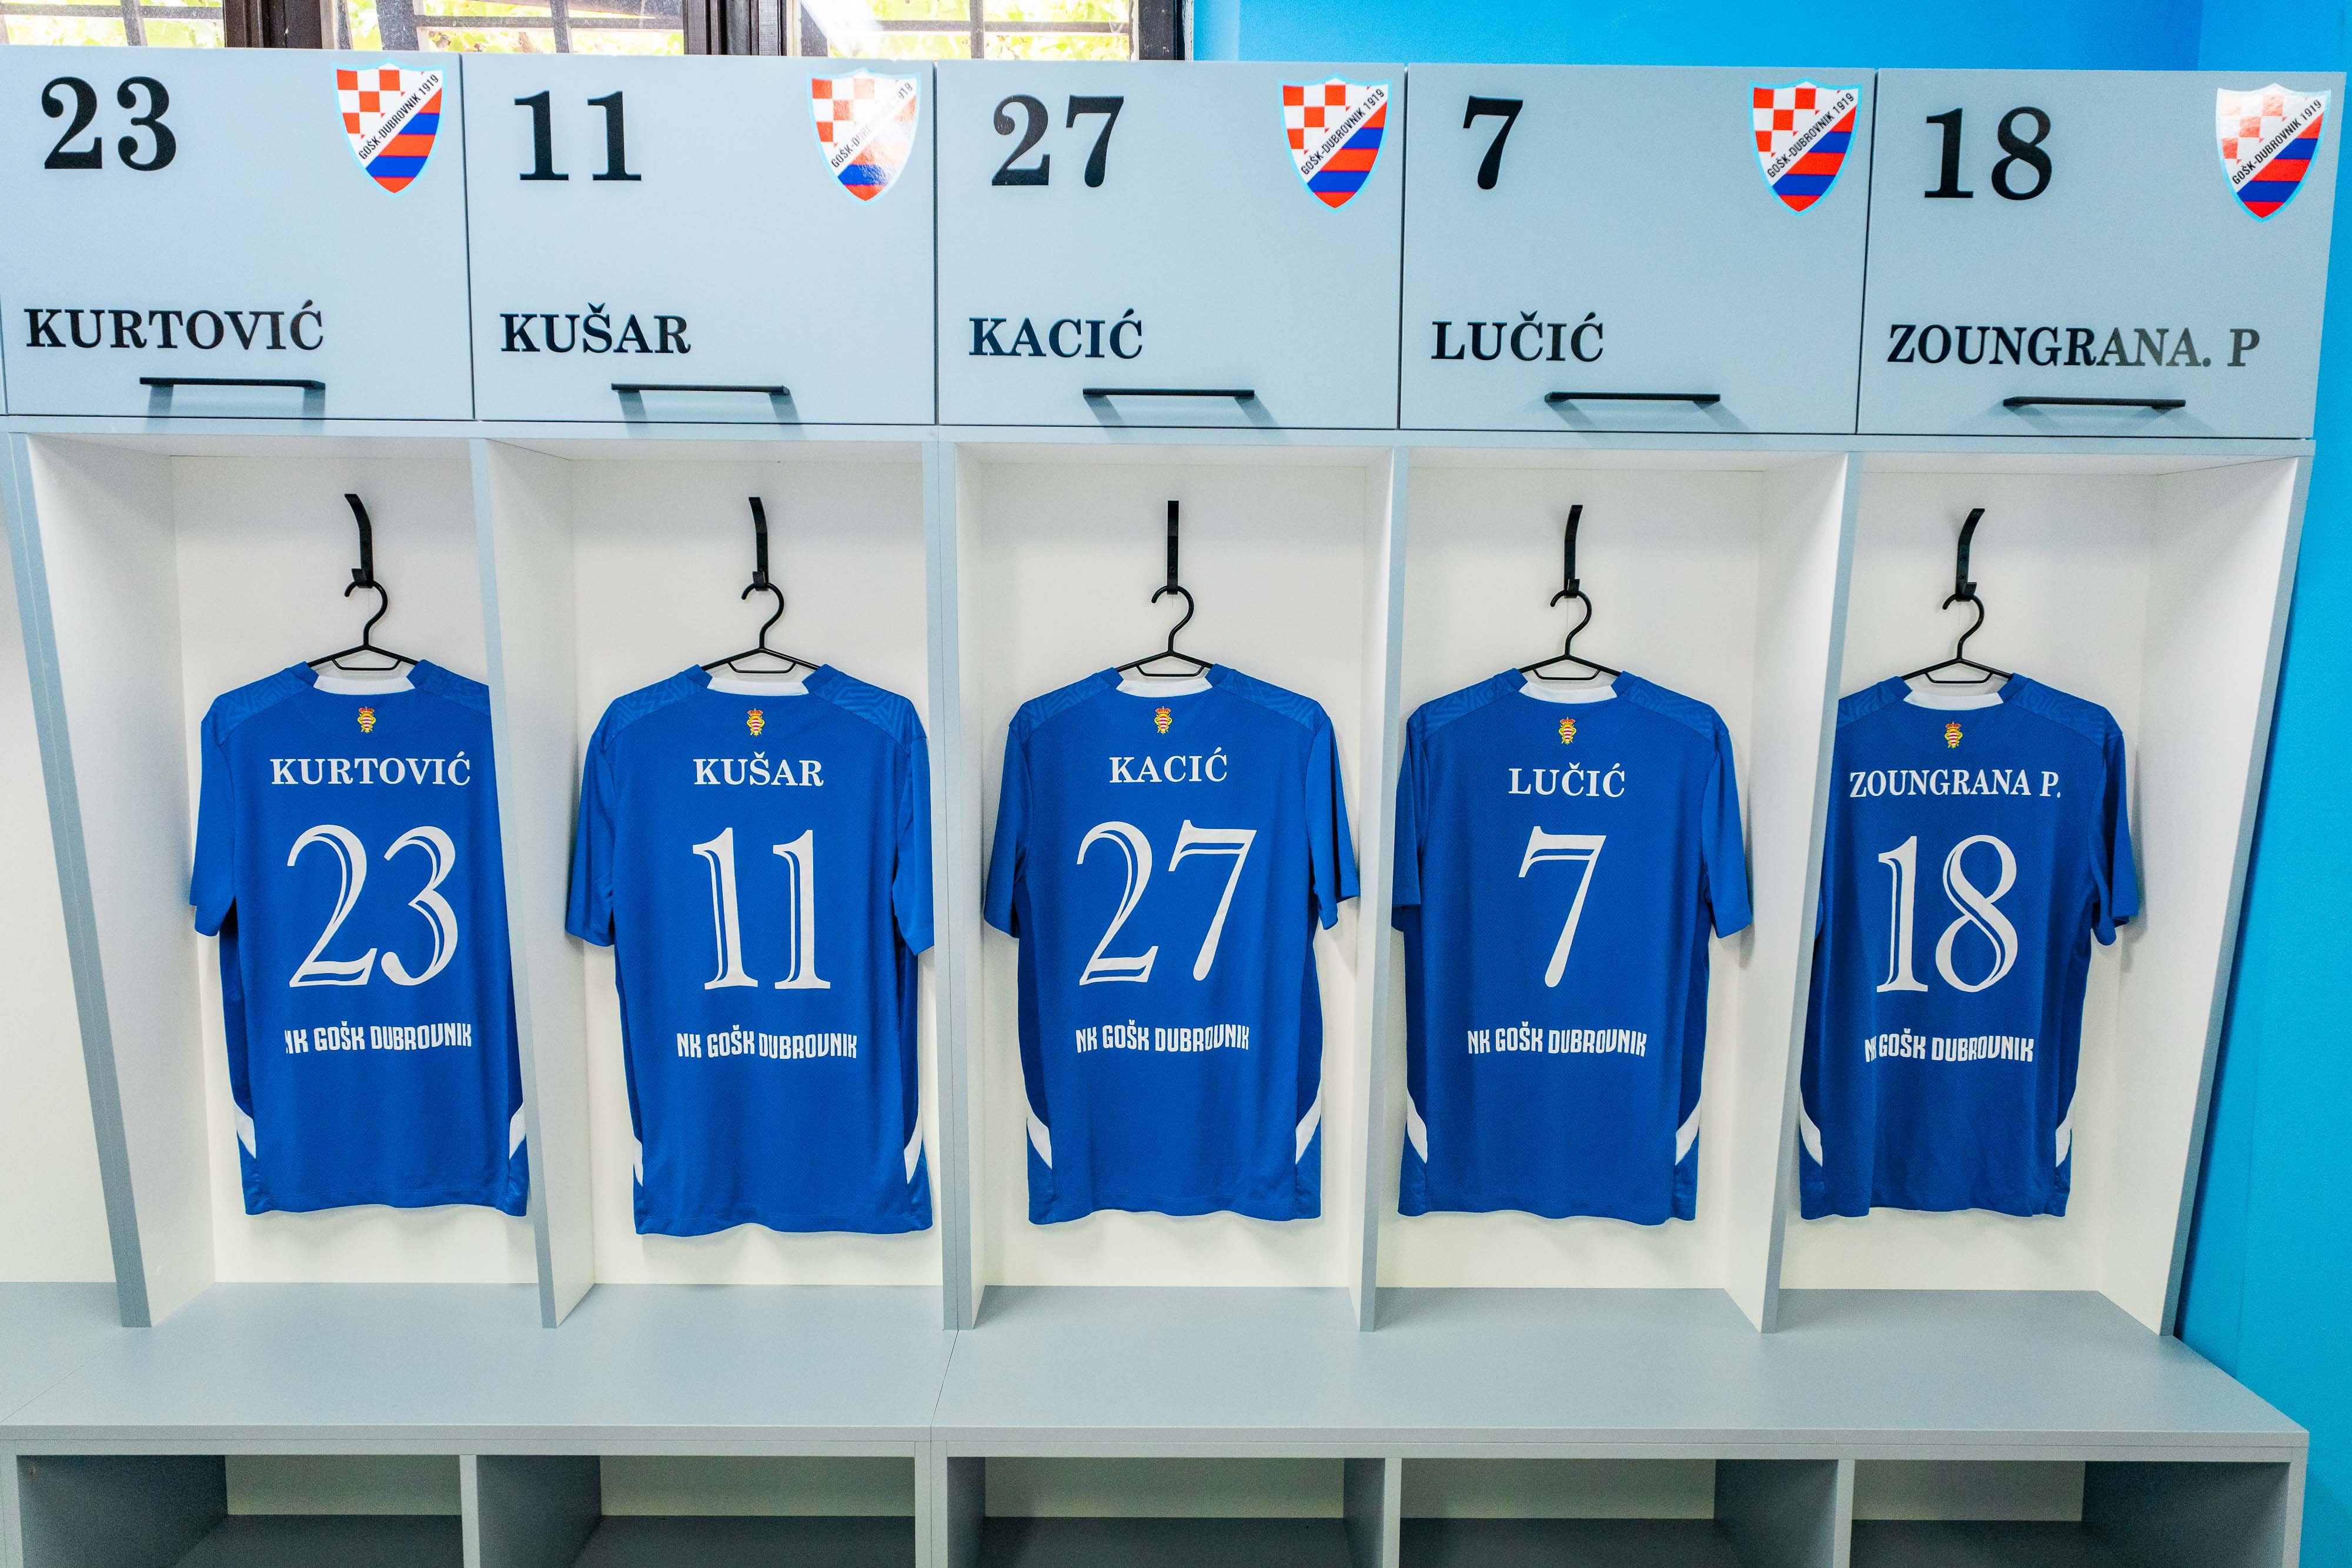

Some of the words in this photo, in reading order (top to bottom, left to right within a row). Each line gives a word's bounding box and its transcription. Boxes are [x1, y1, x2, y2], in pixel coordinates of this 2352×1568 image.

[41, 76, 177, 172] 23
[358, 92, 422, 160] GOŠK-DUBROVNIK
[418, 73, 439, 96] 1919
[514, 90, 642, 181] 11
[991, 95, 1124, 188] 27
[1300, 106, 1366, 175] GOŠK-DUBROVNIK
[1363, 88, 1385, 110] 1919
[1462, 95, 1524, 190] 7
[1766, 111, 1835, 178] GOŠK-DUBROVNIK
[1832, 92, 1855, 115] 1919
[2231, 117, 2302, 185] GOŠK-DUBROVNIK
[2300, 99, 2322, 121] 1919
[1924, 105, 2052, 201] 18
[24, 299, 324, 351] KURTOVIĆ
[499, 302, 691, 354] KUŠAR
[968, 307, 1143, 360] KACIĆ
[1431, 310, 1604, 363] LUČIĆ
[1887, 323, 2212, 368] ZOUNGRANA.
[2227, 327, 2260, 367] P
[269, 751, 471, 787] KURTOVIĆ
[693, 750, 824, 787] KUŠAR
[1108, 747, 1228, 784] KACIĆ
[1508, 761, 1625, 798] LUČIĆ
[1849, 768, 2032, 798] ZOUNGRANA
[2039, 770, 2062, 799] P.
[286, 824, 459, 988] 23
[692, 827, 831, 991] 11
[1076, 819, 1257, 987] 27
[1518, 825, 1607, 988] 7
[1876, 834, 2019, 994] 18
[313, 1021, 366, 1052] GOŠK
[369, 1022, 472, 1051] DUBROVNIK
[676, 1033, 703, 1058] NK
[706, 1024, 755, 1058] GOŠK
[759, 1032, 857, 1060] DUBROVNIK
[1075, 1025, 1098, 1054] NK
[1102, 1019, 1150, 1051] GOŠK
[1155, 1024, 1250, 1053] DUBROVNIK
[1467, 1029, 1491, 1054] NK
[1495, 1021, 1544, 1052] GOŠK
[1547, 1029, 1647, 1057] DUBROVNIK
[1879, 1027, 1926, 1059] GOŠK
[1930, 1035, 2034, 1062] DUBROVNIK
